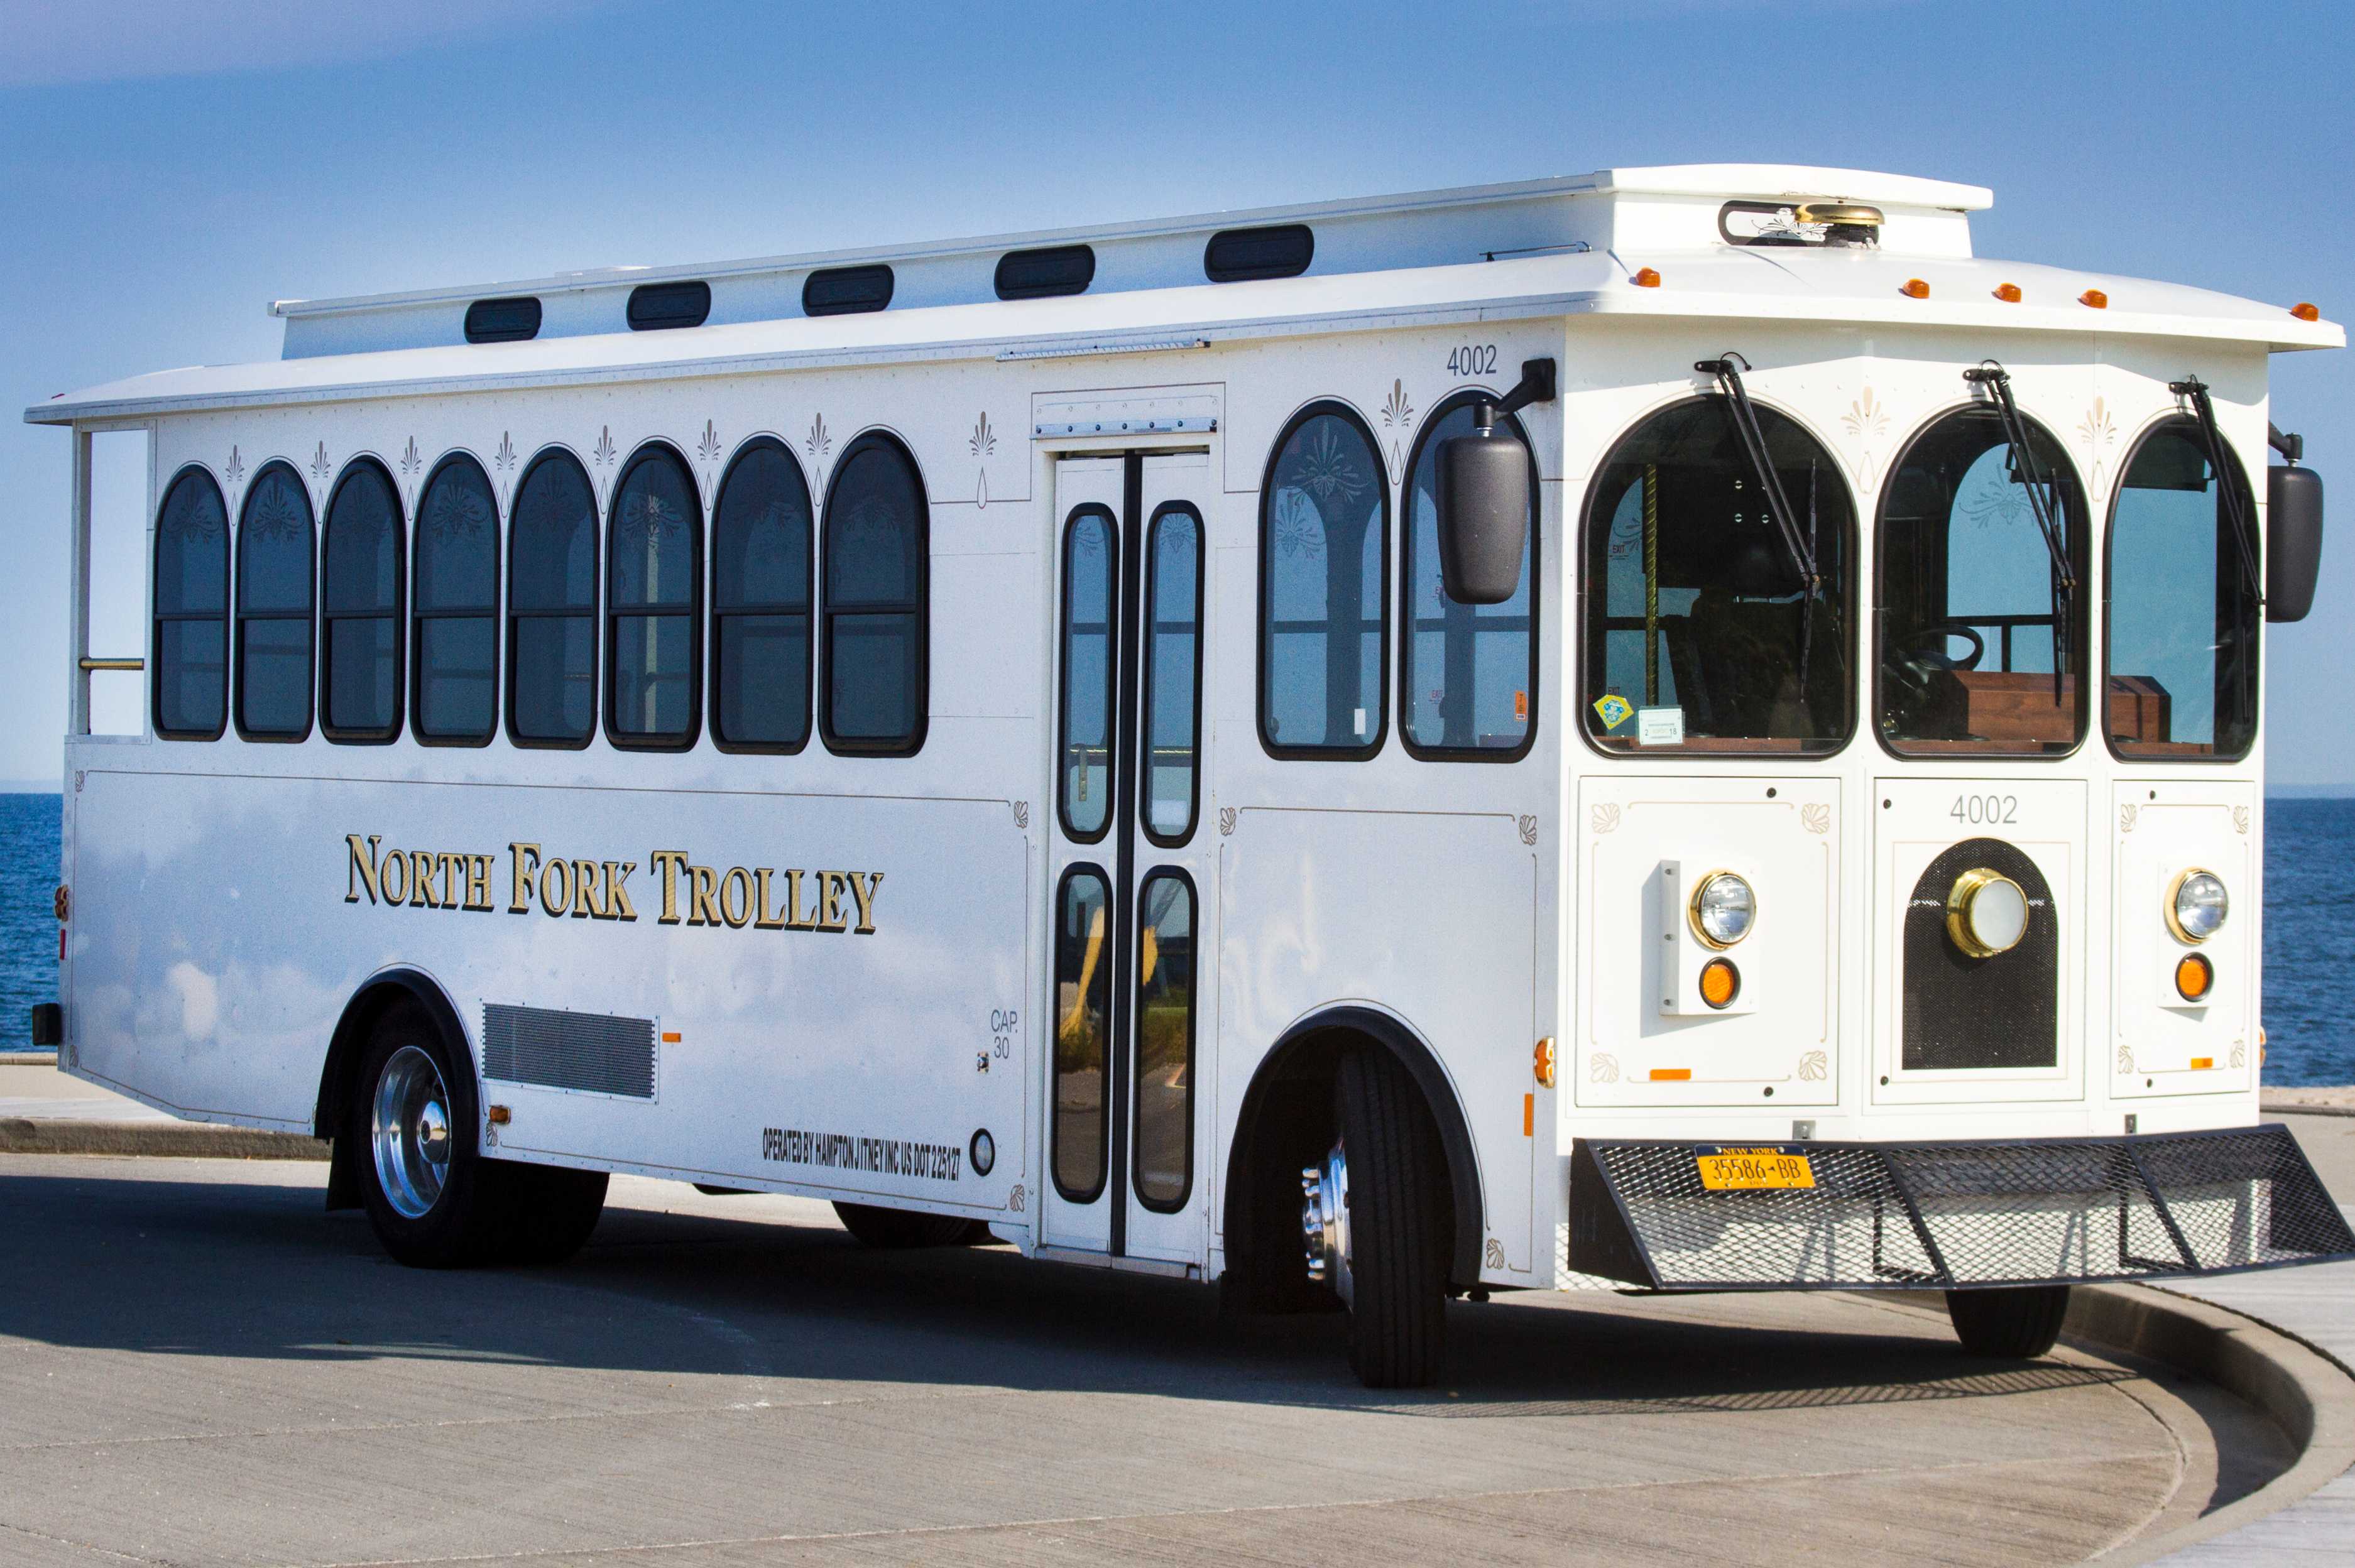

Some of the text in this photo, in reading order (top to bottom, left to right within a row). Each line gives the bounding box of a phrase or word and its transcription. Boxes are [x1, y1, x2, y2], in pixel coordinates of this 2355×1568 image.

[1447, 344, 1497, 376] 4002
[1950, 795, 2017, 824] 4002
[345, 834, 884, 935] NORTH FORK TROLLEY
[991, 1010, 1018, 1033] CAP.
[994, 1036, 1009, 1059] 30
[763, 1127, 961, 1181] OPERATED BY HAMPTON JITNEY INC US DOT 225127
[1751, 1147, 1779, 1155] YORK
[1709, 1158, 1801, 1180] 35586-BB
